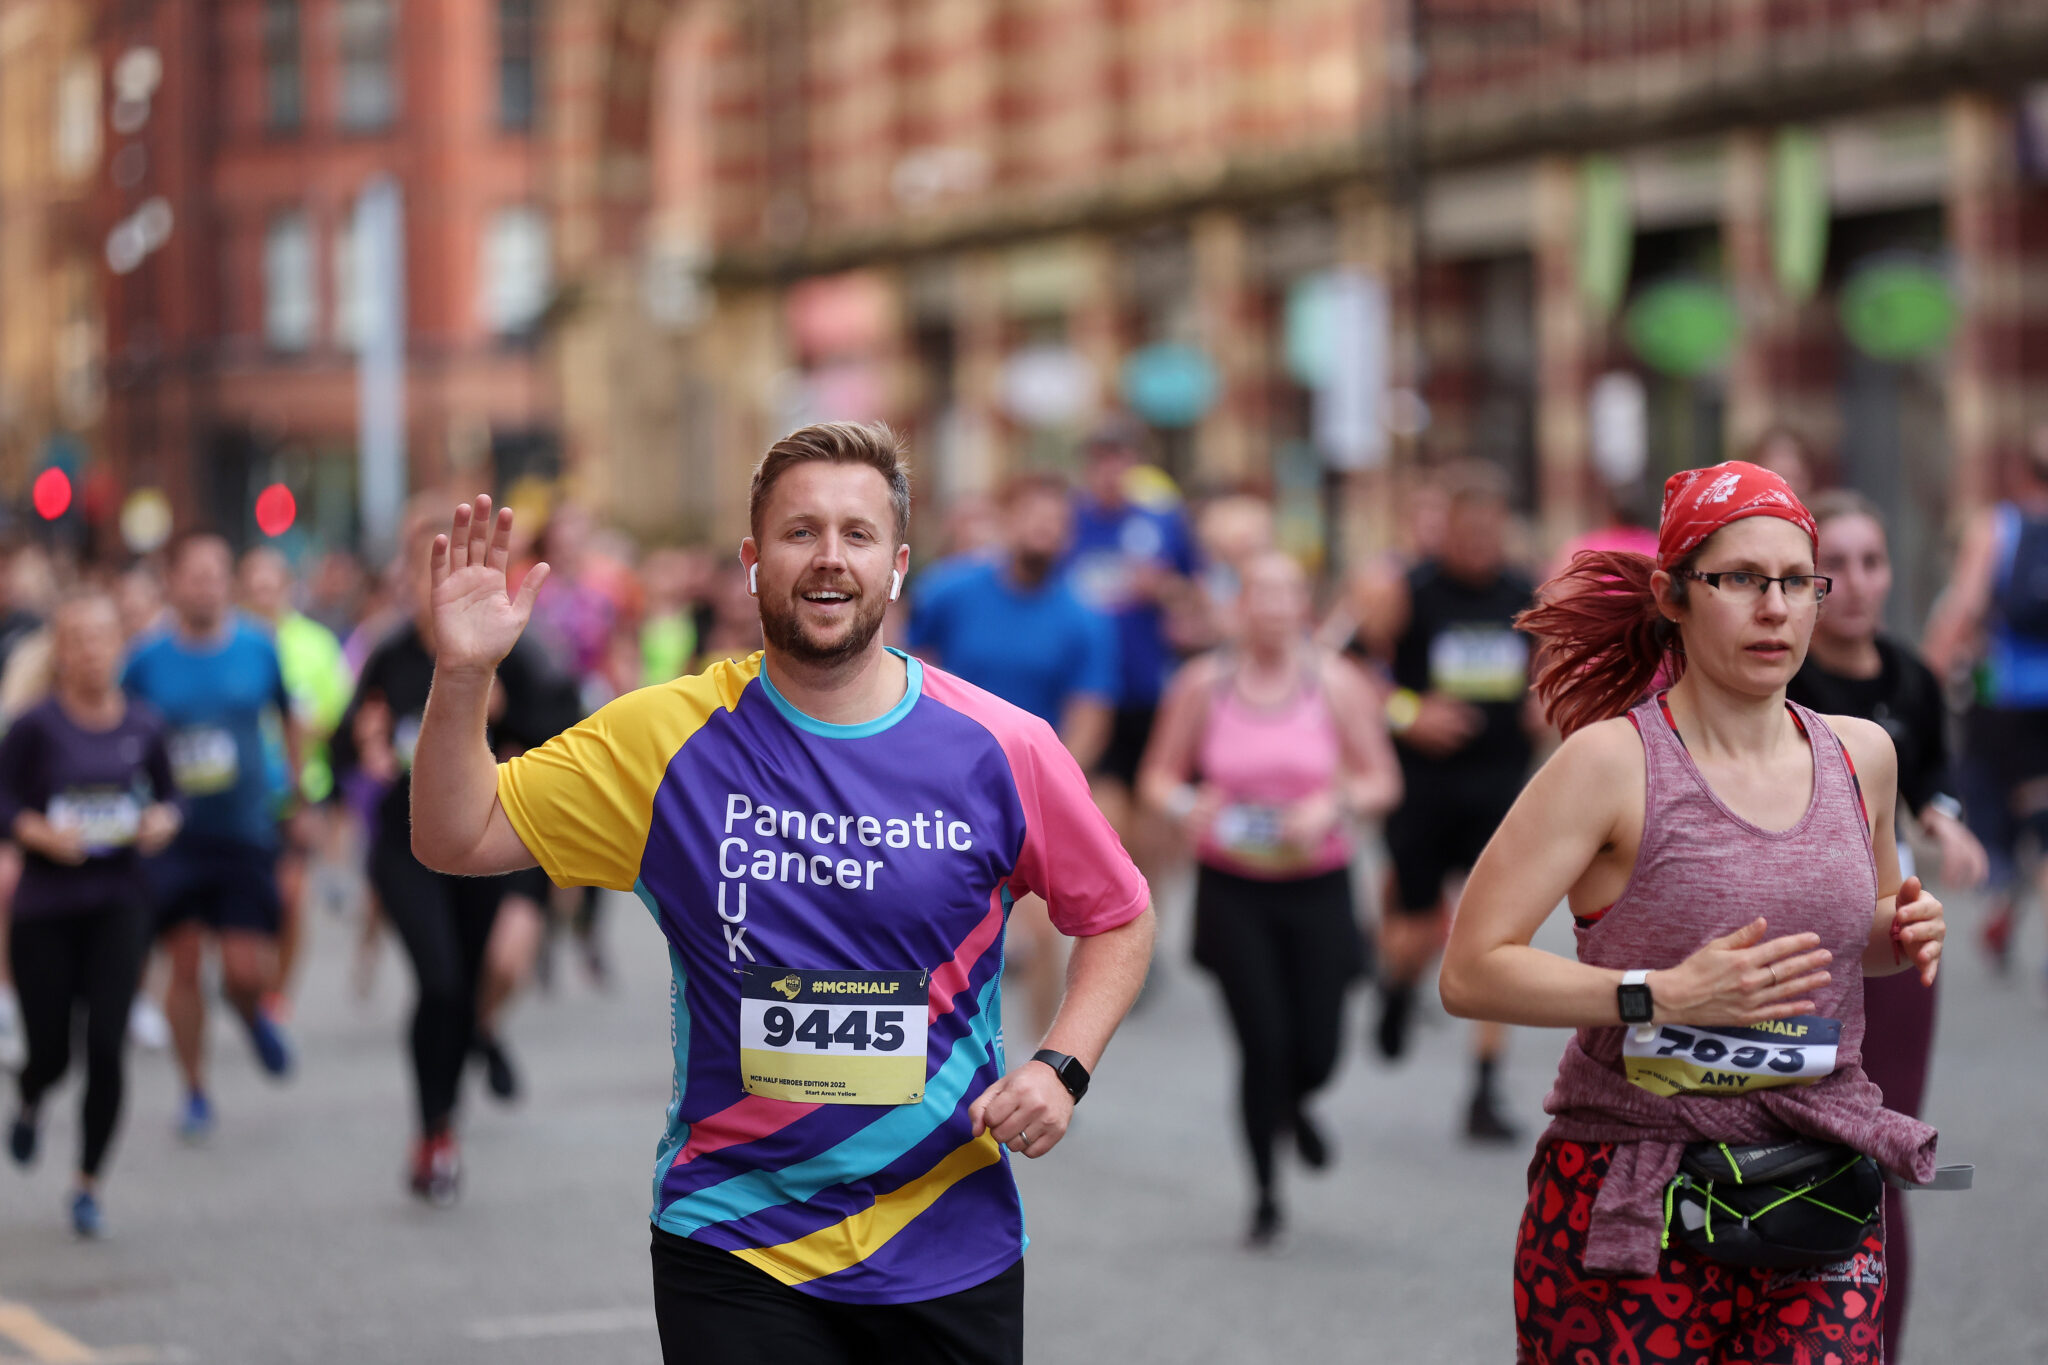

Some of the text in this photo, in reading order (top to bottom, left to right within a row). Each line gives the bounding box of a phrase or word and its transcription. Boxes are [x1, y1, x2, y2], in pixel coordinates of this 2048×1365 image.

[725, 793, 973, 852] Pancreatic
[719, 836, 884, 891] Cancer
[812, 981, 899, 994] #MCRHALF
[763, 1006, 905, 1052] 9445
[750, 1074, 846, 1089] MCR HALF HEROES EDITION 2022
[1700, 1071, 1751, 1087] AMY
